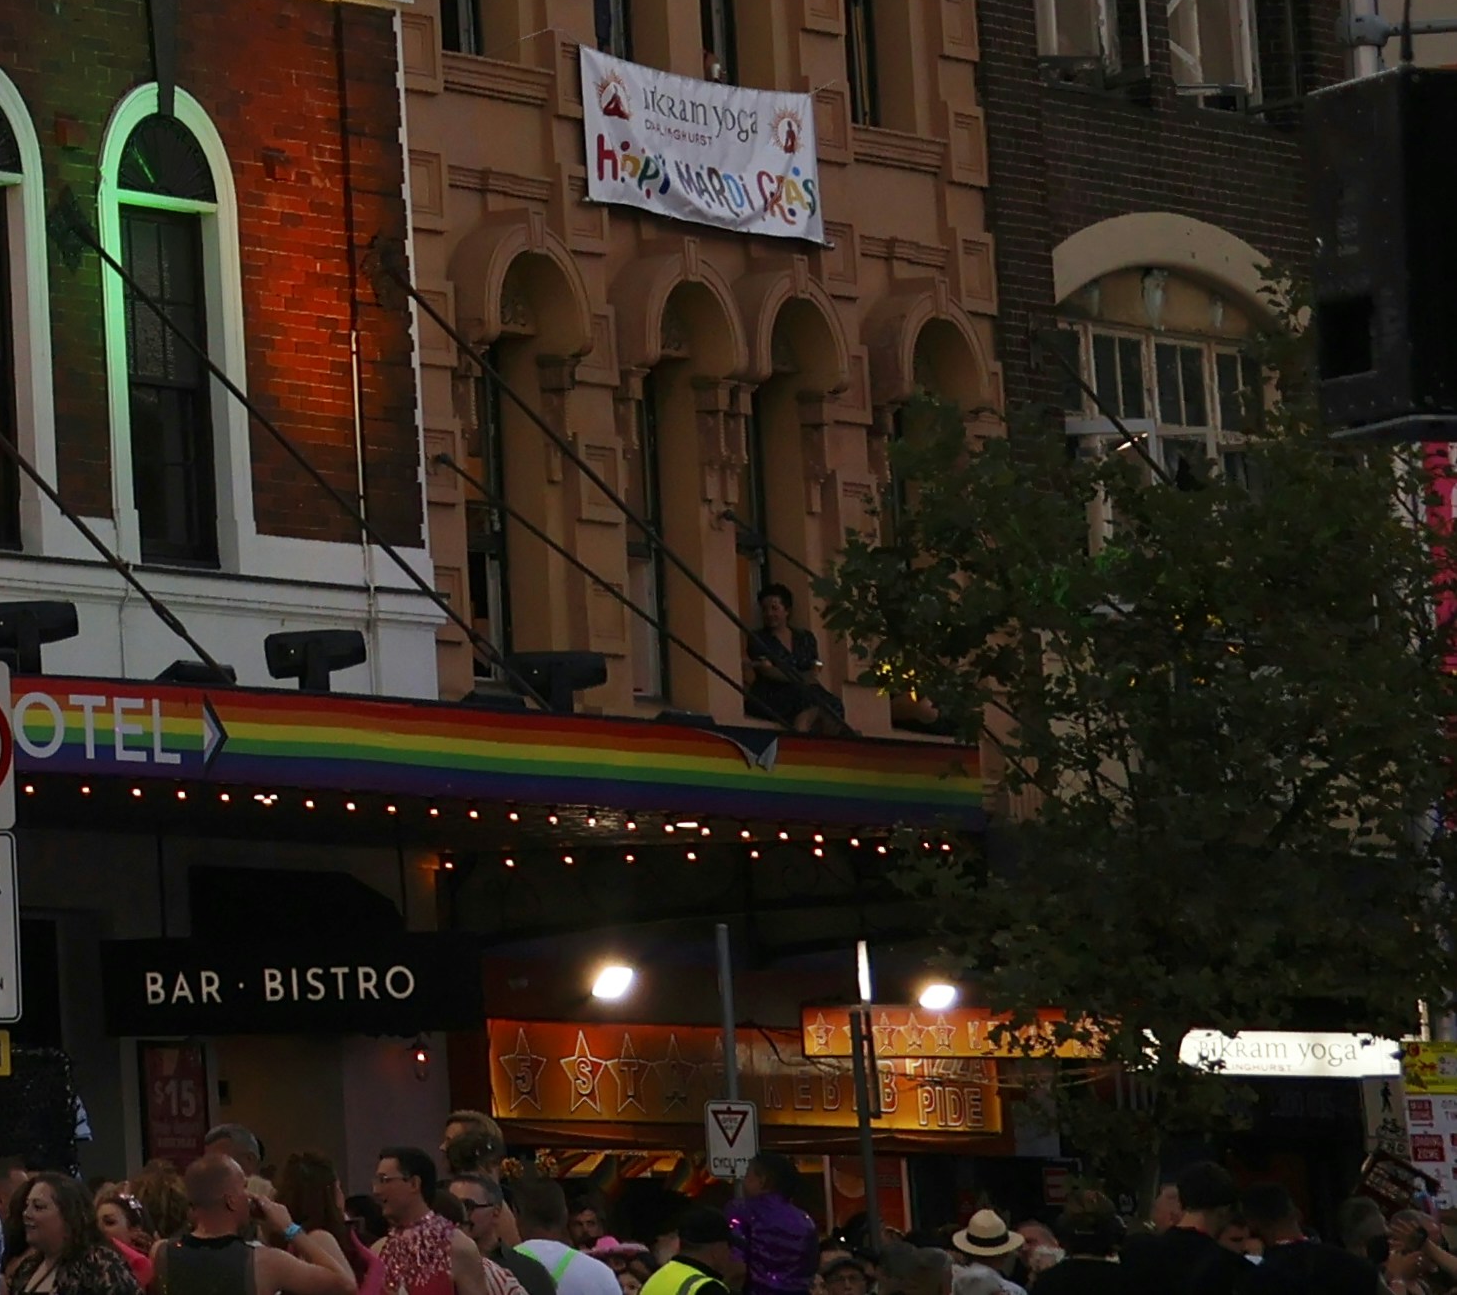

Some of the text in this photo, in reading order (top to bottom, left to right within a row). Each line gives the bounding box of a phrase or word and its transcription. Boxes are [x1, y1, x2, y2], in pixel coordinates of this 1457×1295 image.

[712, 105, 759, 143] yoga
[13, 690, 183, 765] OTEL
[145, 965, 416, 1005] BAR BISTRO
[816, 1026, 827, 1045] 5
[1297, 1041, 1358, 1068] yoga
[154, 1078, 197, 1118] $15
[516, 1056, 532, 1094] 5
[763, 1057, 898, 1114] KEBB
[917, 1086, 986, 1128] PIDE
